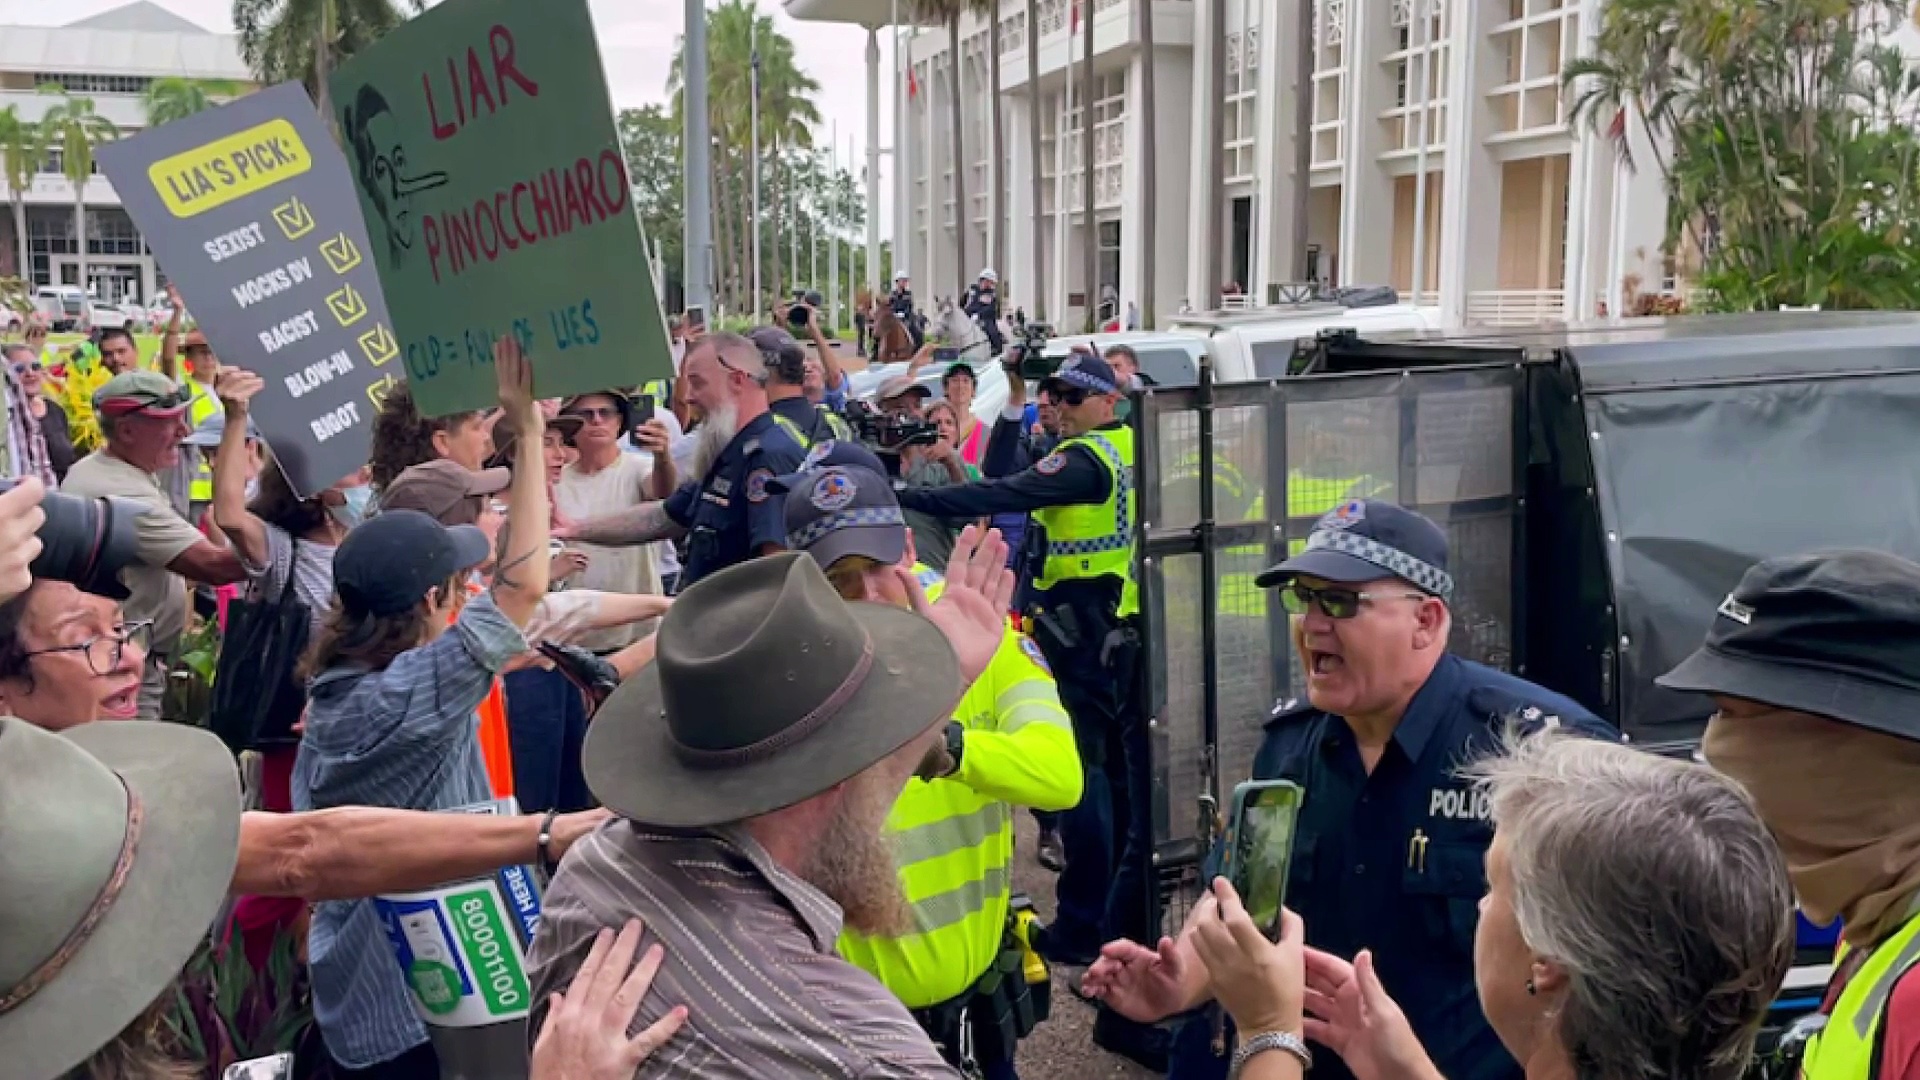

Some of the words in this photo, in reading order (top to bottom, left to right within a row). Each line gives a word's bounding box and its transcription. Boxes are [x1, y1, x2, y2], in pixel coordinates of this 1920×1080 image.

[423, 24, 538, 139] LIAR
[167, 158, 233, 203] LIA'S
[234, 137, 298, 182] PICK:
[203, 221, 266, 262] SEXIST
[422, 149, 630, 284] PINOCCHIARO
[231, 268, 291, 308] MOCKS
[287, 256, 314, 283] DV
[257, 310, 320, 353] RACIST
[549, 298, 600, 350] LIES
[283, 350, 354, 398] BLOW-IN
[310, 401, 361, 443] BIGOT
[1428, 788, 1493, 820] POLIC
